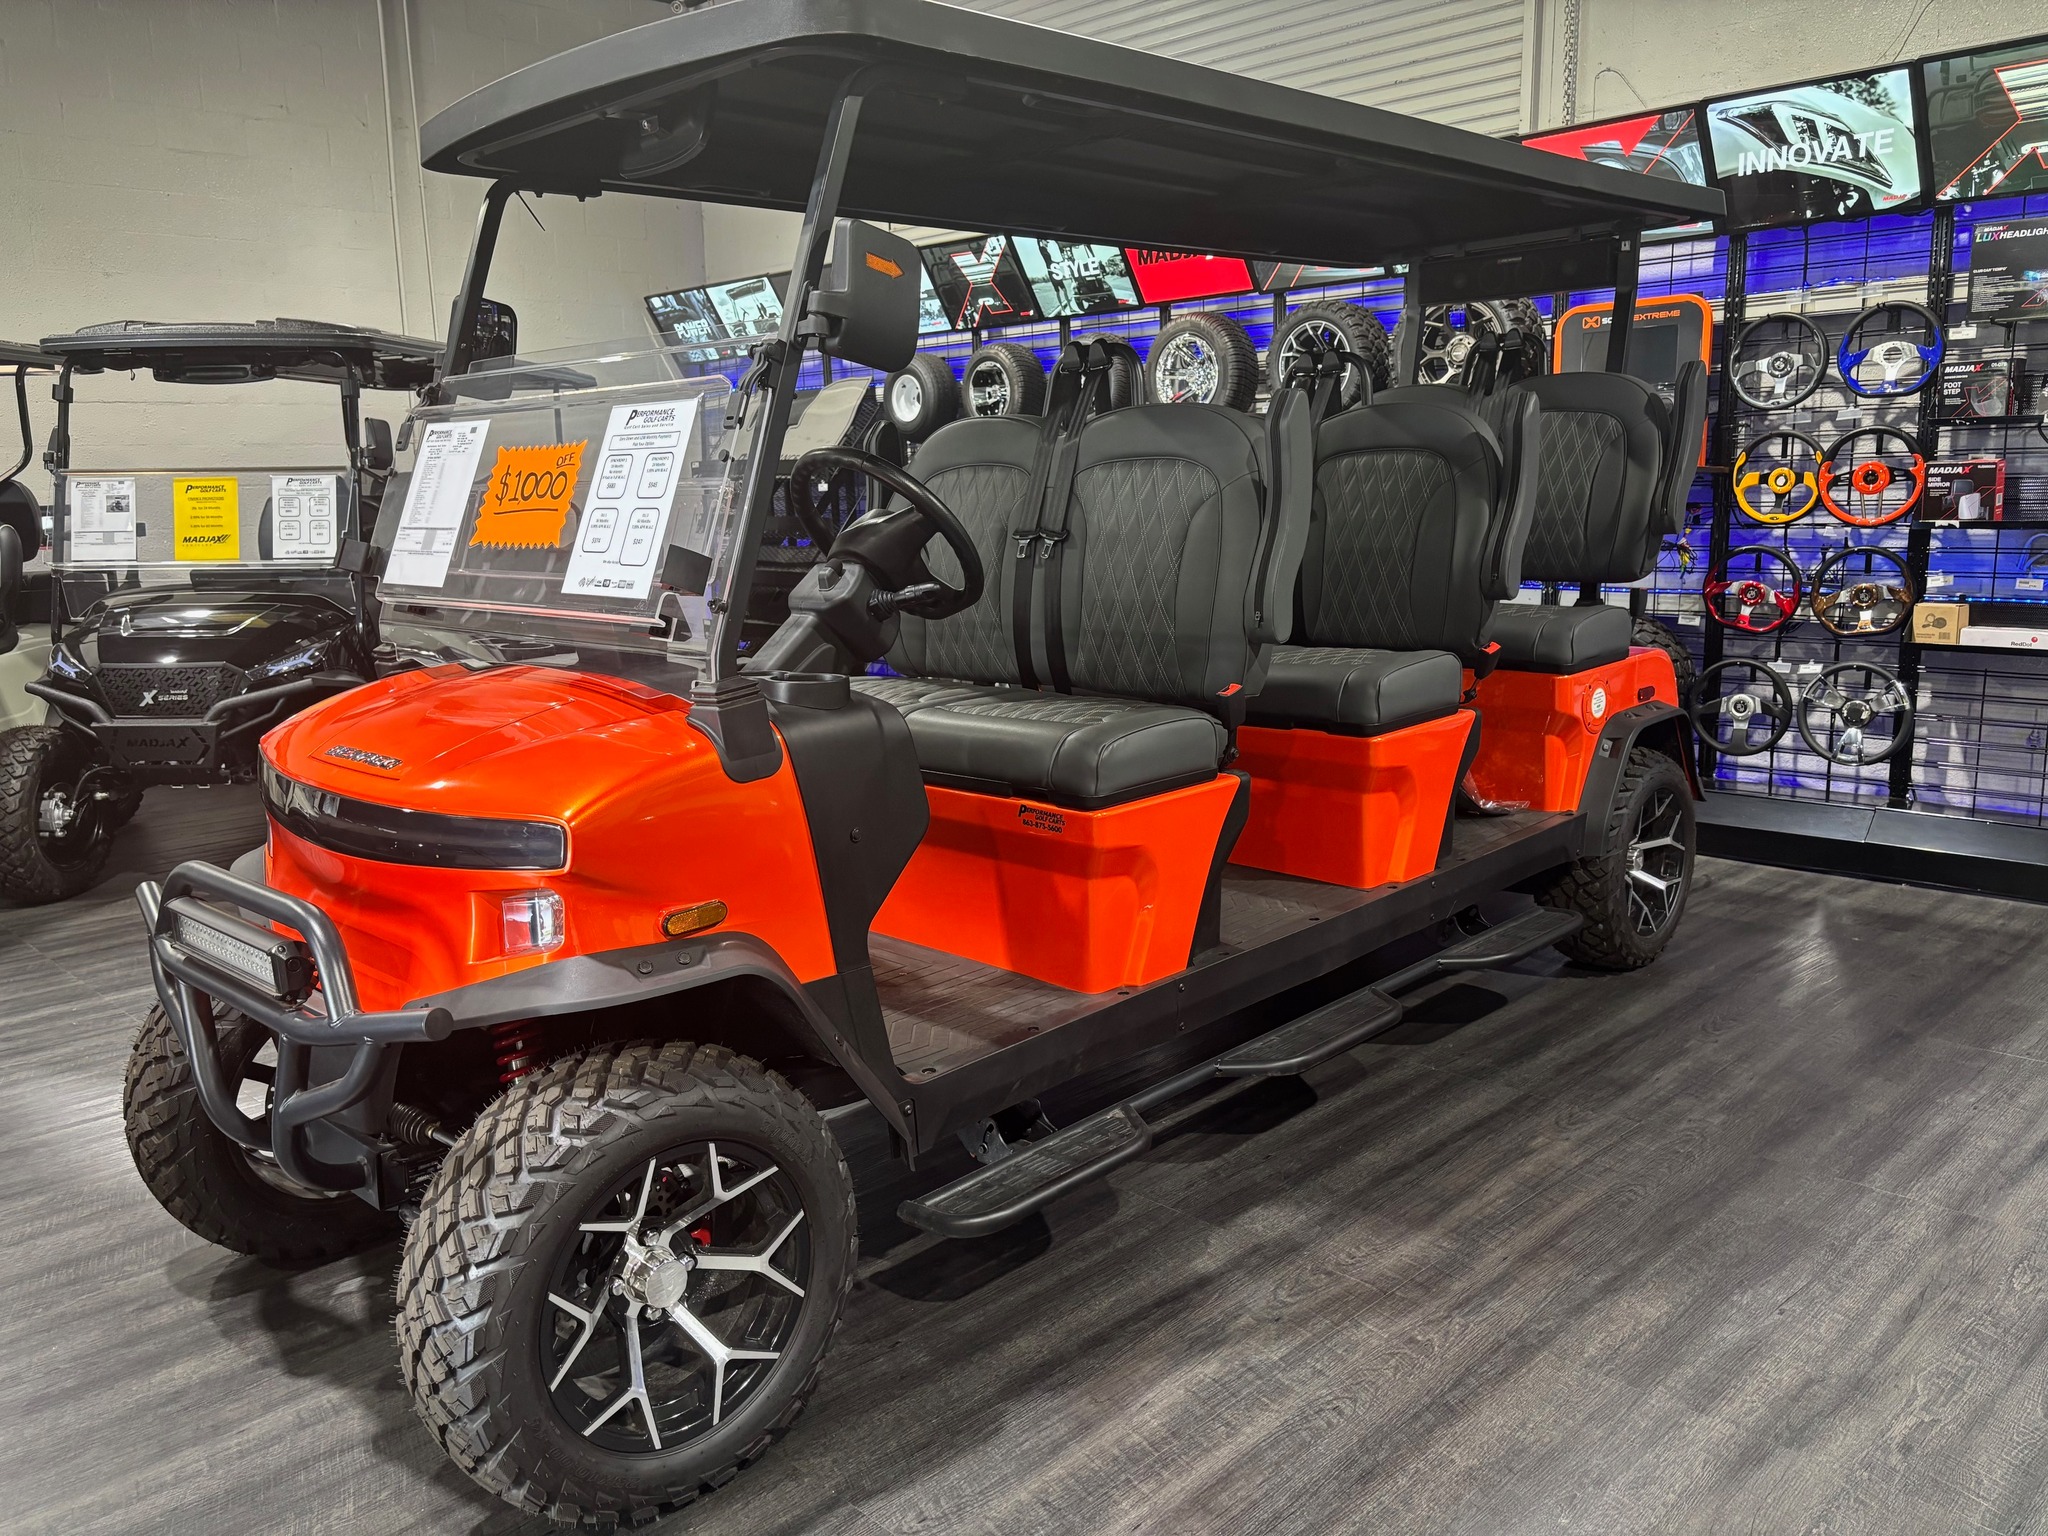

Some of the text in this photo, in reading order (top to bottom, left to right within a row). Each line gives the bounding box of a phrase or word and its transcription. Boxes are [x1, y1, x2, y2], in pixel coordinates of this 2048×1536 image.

[1737, 128, 1894, 177] INNOVATE
[1983, 224, 2010, 233] MADJAX
[1049, 257, 1101, 281] STYLE
[1633, 309, 1681, 321] EXTREME
[674, 318, 712, 339] POWER
[1944, 363, 1984, 373] MADJAX
[1943, 381, 1962, 389] FOOT
[1943, 388, 1961, 396] STEP
[625, 408, 676, 426] PERFORMANCE
[643, 414, 676, 424] GOLF CARTS
[556, 452, 575, 466] OFF
[1928, 465, 1973, 475] MADJAX
[185, 484, 225, 494] PERFORMANCE
[183, 534, 231, 544] MADJAX
[139, 689, 158, 707] X
[126, 737, 190, 749] MADJAX
[1018, 804, 1064, 821] PERFORMANCE
[1035, 814, 1066, 826] GOLF CARTS
